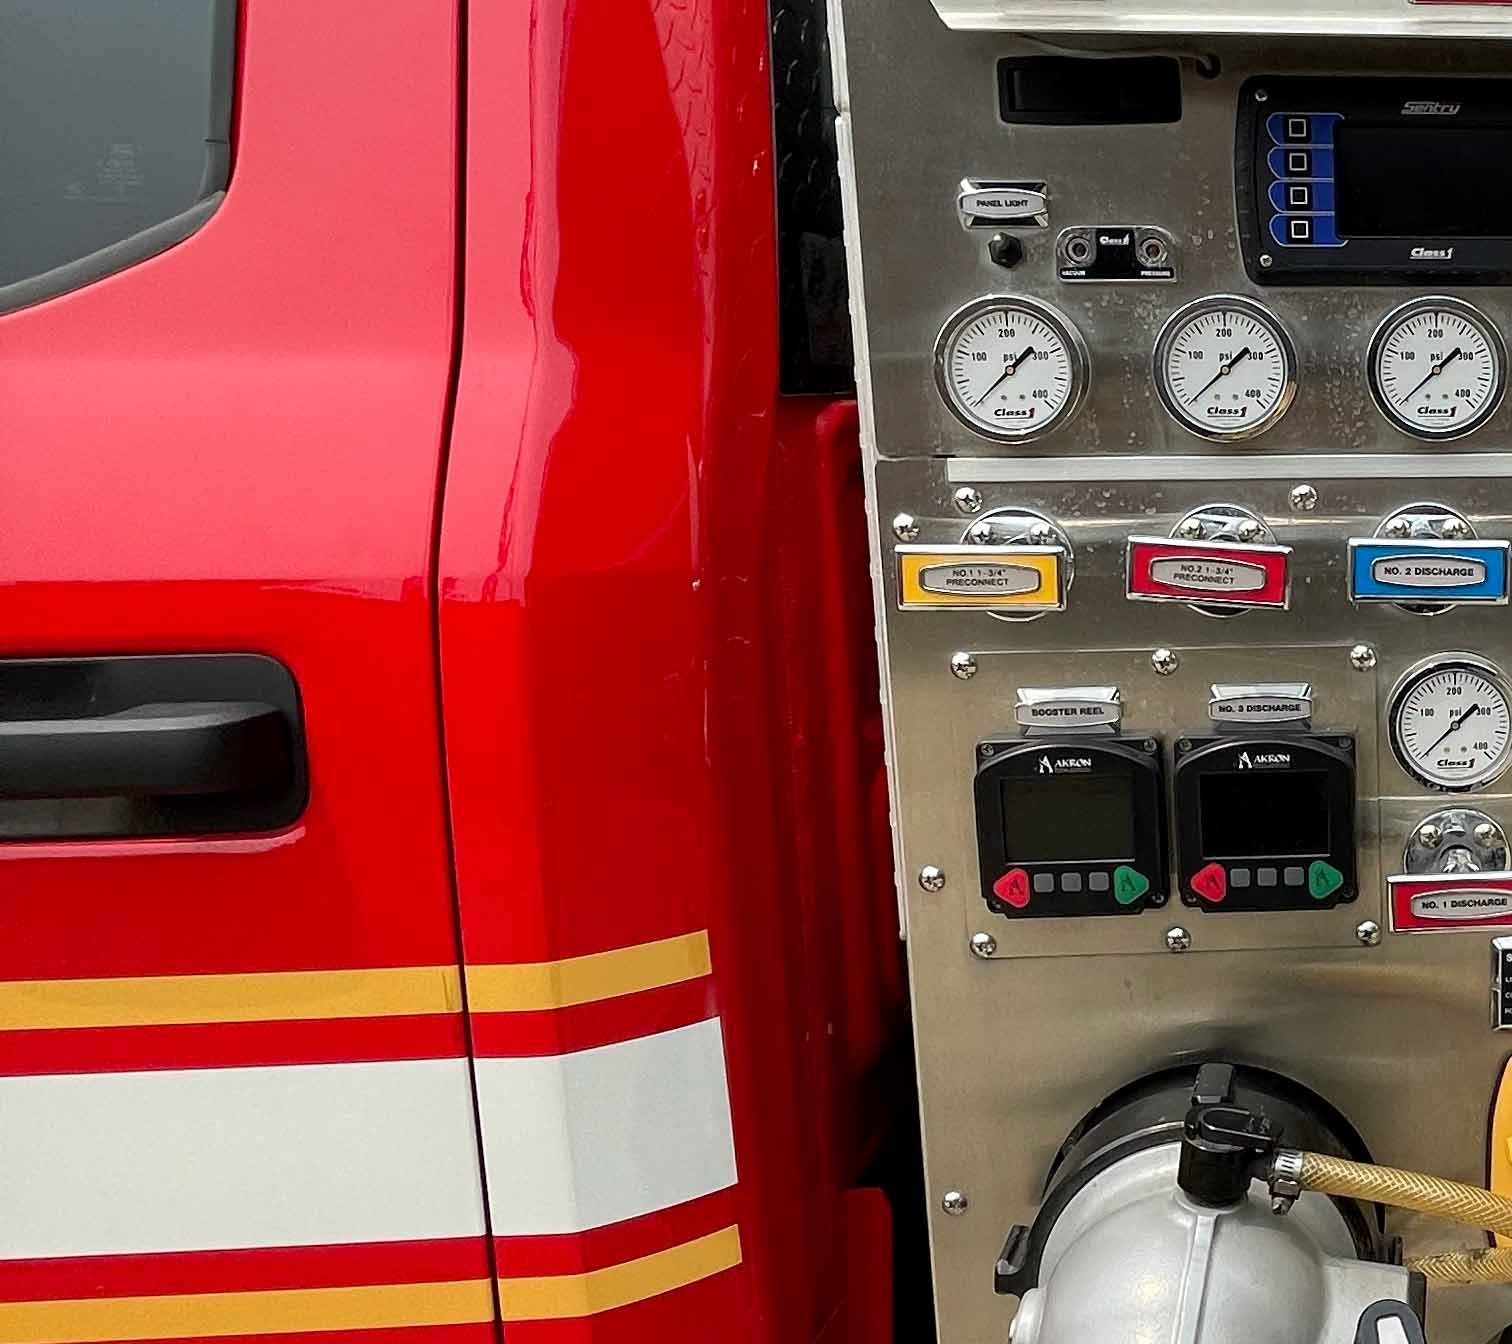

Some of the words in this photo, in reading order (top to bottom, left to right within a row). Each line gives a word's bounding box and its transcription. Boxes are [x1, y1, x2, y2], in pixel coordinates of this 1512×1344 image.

[1401, 101, 1460, 115] Sentry
[976, 199, 1002, 207] PANEL
[1005, 199, 1028, 207] LIGHT
[998, 329, 1015, 338] 200
[1216, 328, 1232, 337] 200
[1427, 329, 1443, 338] 200
[971, 352, 987, 361] 100
[1032, 352, 1049, 360] 300
[1188, 351, 1203, 360] 100
[1247, 352, 1263, 360] 300
[1400, 352, 1415, 360] 100
[1458, 352, 1474, 360] 300
[1032, 390, 1048, 398] 400
[1245, 390, 1261, 398] 400
[1454, 389, 1470, 397] 400
[1384, 567, 1402, 576] NO.
[1405, 568, 1411, 576] 2
[1414, 568, 1474, 576] DISCHARGE
[946, 578, 1008, 586] PRECONNECT
[1173, 573, 1235, 584] PRECONNECT
[1446, 687, 1462, 695] 200
[1031, 706, 1077, 717] BOOSTER
[1079, 706, 1104, 716] REEL
[1218, 705, 1235, 713] NO.
[1247, 704, 1301, 712] DISCHARGE
[1420, 708, 1434, 716] 100
[1477, 707, 1491, 716] 300
[1473, 742, 1488, 750] 400
[1054, 757, 1092, 768] AKRON
[1253, 754, 1290, 764] AKRON
[1422, 901, 1439, 909] NO.
[1450, 898, 1508, 908] DISCHARGE
